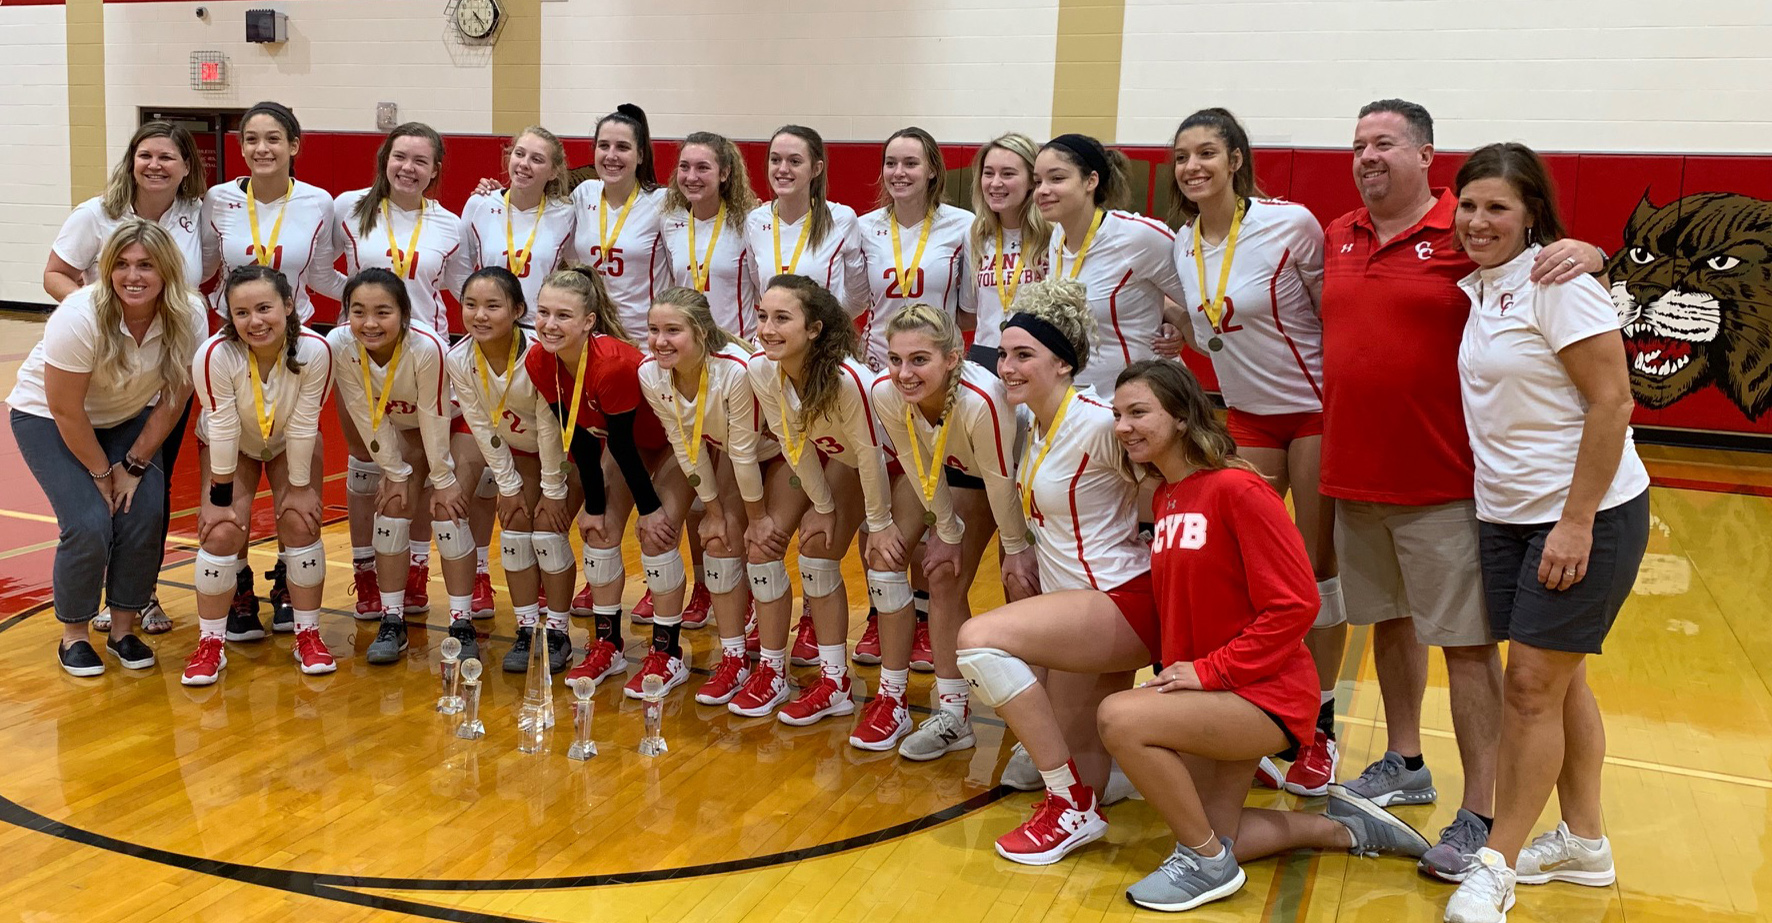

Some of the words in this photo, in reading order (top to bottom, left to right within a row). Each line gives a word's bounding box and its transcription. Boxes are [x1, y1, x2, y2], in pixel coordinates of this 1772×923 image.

[179, 216, 194, 233] CC
[590, 245, 624, 277] 25
[1415, 241, 1434, 260] CC
[883, 267, 924, 298] 20
[502, 409, 526, 434] 2
[815, 436, 845, 455] 3
[1151, 512, 1208, 555] CVB
